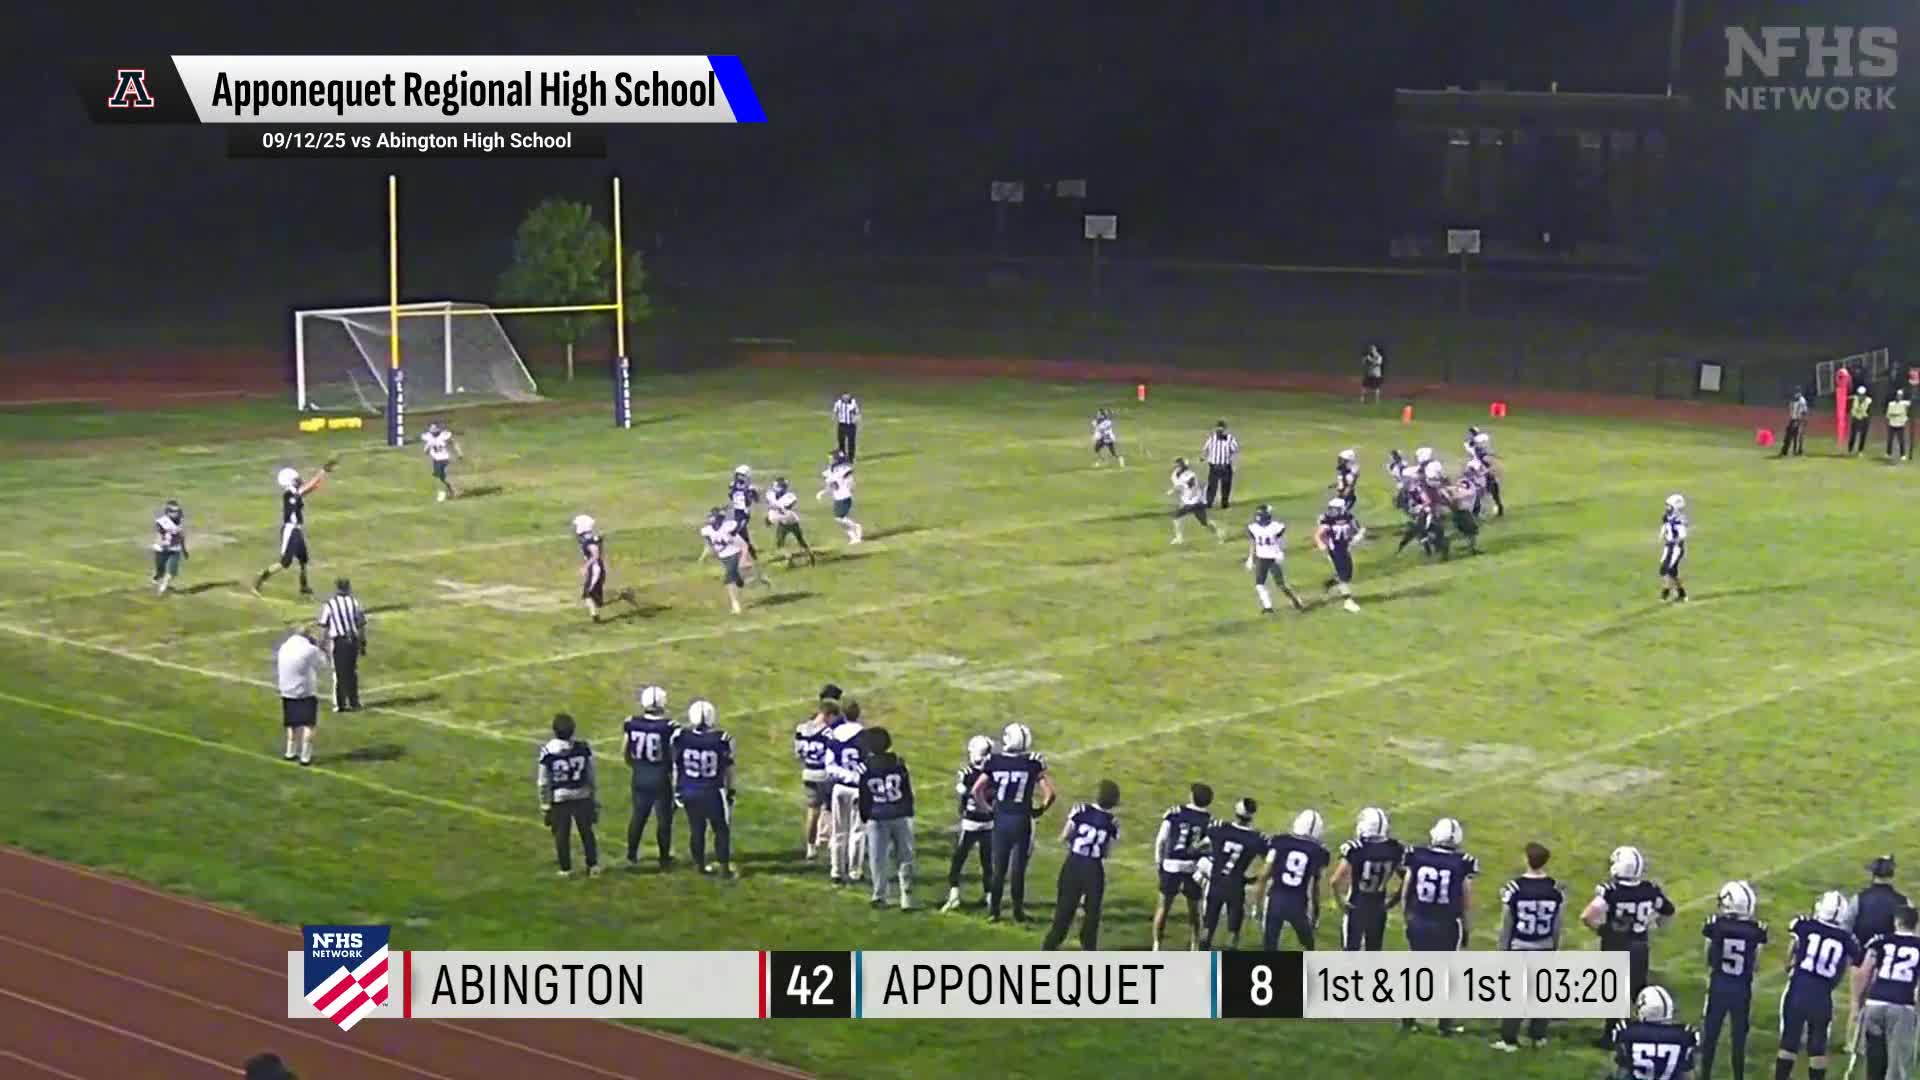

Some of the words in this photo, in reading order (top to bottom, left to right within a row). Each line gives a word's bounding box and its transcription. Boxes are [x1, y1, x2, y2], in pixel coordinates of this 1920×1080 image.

[992, 770, 1028, 802] 77
[1072, 824, 1107, 858] 21
[1221, 841, 1243, 875] 7
[1281, 850, 1308, 887] 9
[1416, 865, 1452, 904] 61
[1516, 899, 1558, 935] 55
[1721, 938, 1746, 976] 5
[1800, 932, 1844, 978] 10
[1878, 943, 1920, 982] 12
[1632, 1043, 1680, 1080] 57
